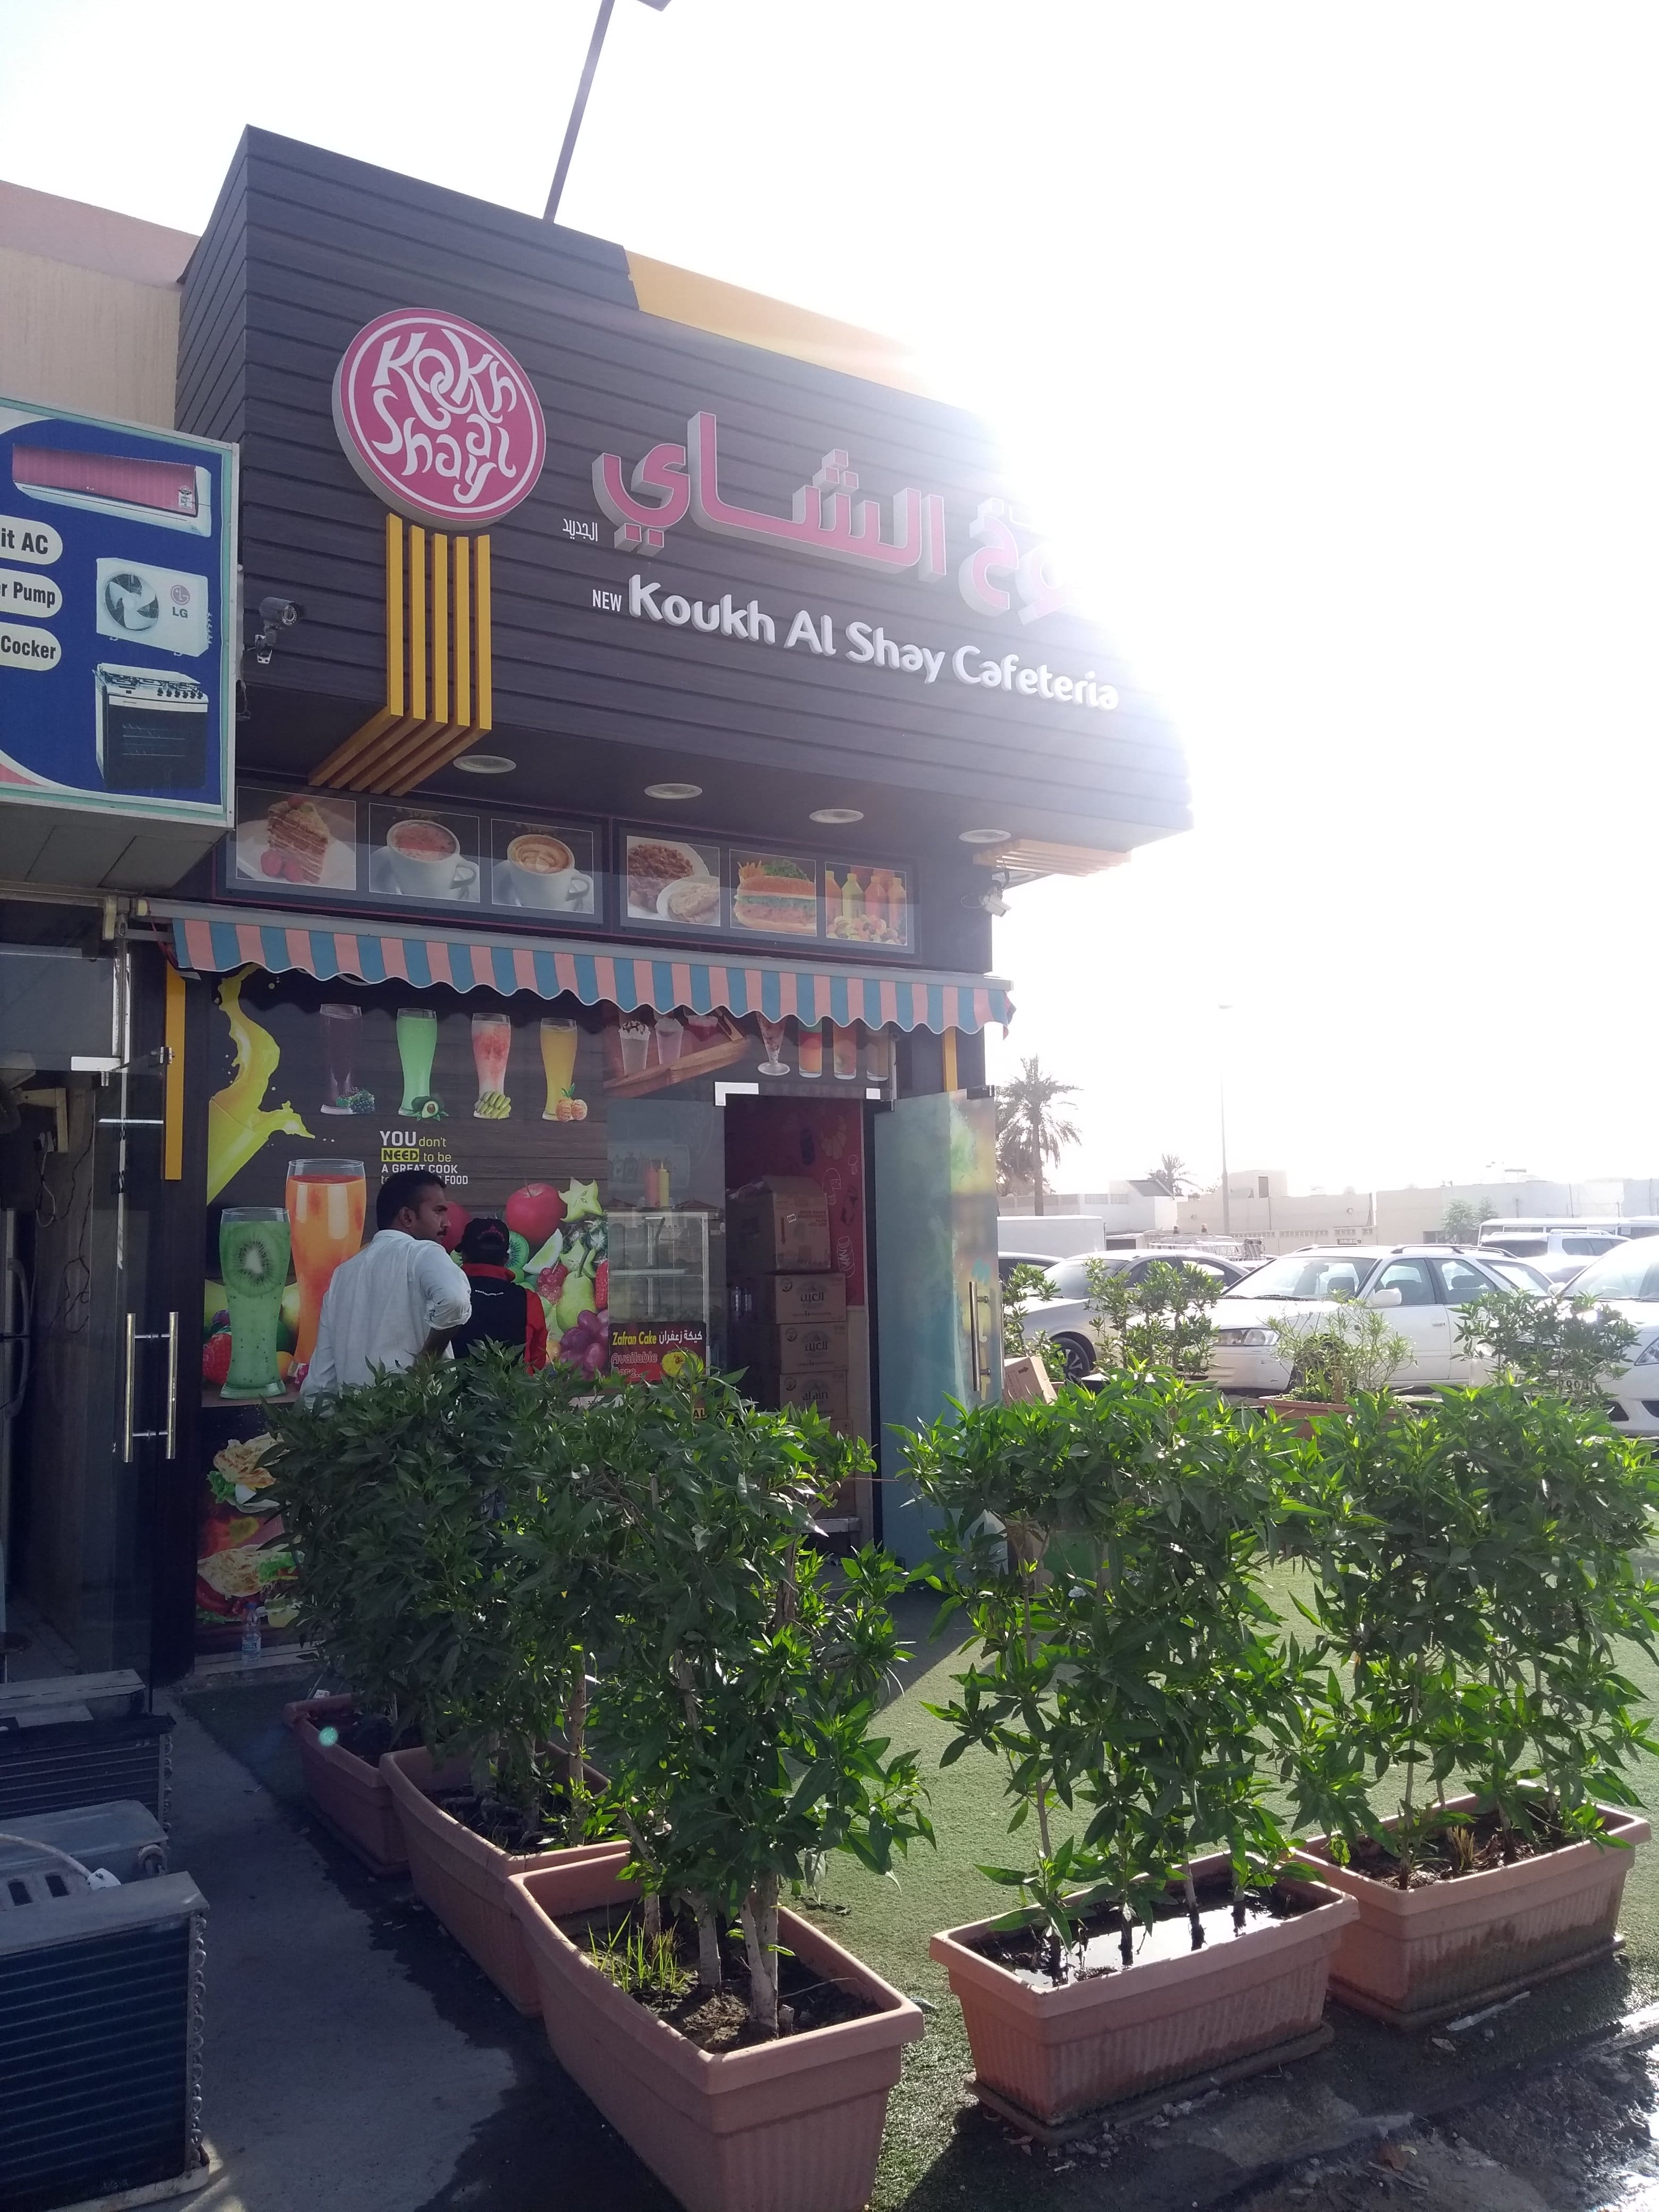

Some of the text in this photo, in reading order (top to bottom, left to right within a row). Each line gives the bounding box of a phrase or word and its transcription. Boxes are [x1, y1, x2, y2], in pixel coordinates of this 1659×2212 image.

[592, 411, 946, 582] الشاي
[563, 518, 598, 542] الجديد
[21, 532, 48, 555] AC
[13, 581, 55, 608] Pump
[172, 607, 188, 618] LG
[1, 635, 56, 659] Cocker
[592, 574, 1119, 711] NEW Koukh Al Shay Cafeteria
[380, 1130, 447, 1147] YOU don't
[383, 1150, 451, 1162] NEED to be
[381, 1164, 458, 1174] A GREAT COOK
[445, 1175, 468, 1185] FOOD
[612, 1330, 657, 1346] Zafran Cake
[683, 1330, 702, 1343] كيكة
[611, 1351, 658, 1364] Available
